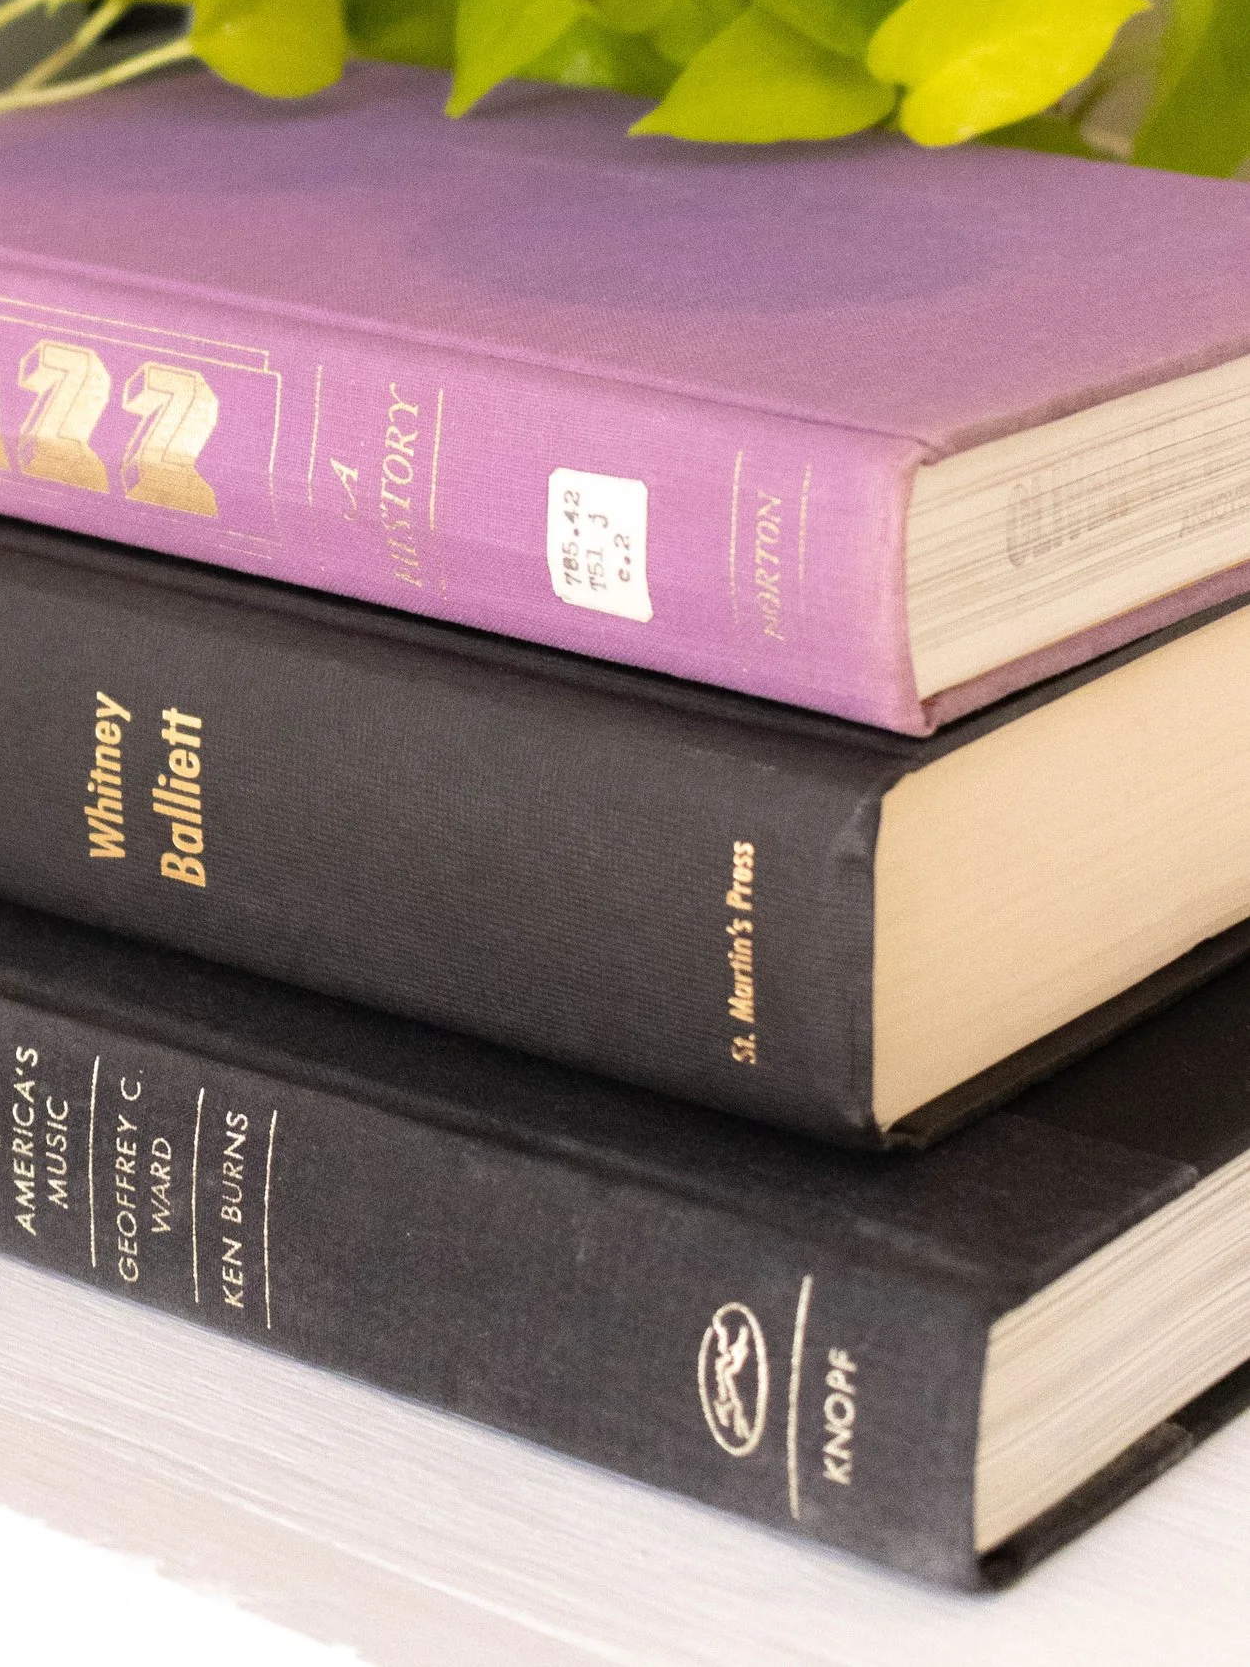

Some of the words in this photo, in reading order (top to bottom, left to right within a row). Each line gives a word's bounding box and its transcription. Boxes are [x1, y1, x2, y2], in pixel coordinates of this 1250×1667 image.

[561, 490, 583, 586] 785.42
[612, 533, 632, 582] c.2
[83, 690, 132, 860] Whitney
[151, 706, 207, 888] Balliett
[725, 840, 756, 912] Press
[725, 917, 756, 1024] Martin's
[119, 1068, 145, 1102] C.
[730, 1032, 757, 1065] St.
[11, 1045, 39, 1237] AMERICA'S
[45, 1095, 70, 1210] MUSIC
[149, 1136, 172, 1234] WARD
[220, 1110, 250, 1224] BURNS
[114, 1113, 140, 1283] GEOFFREY
[220, 1236, 245, 1310] KEN
[821, 1346, 858, 1487] KNOPF
